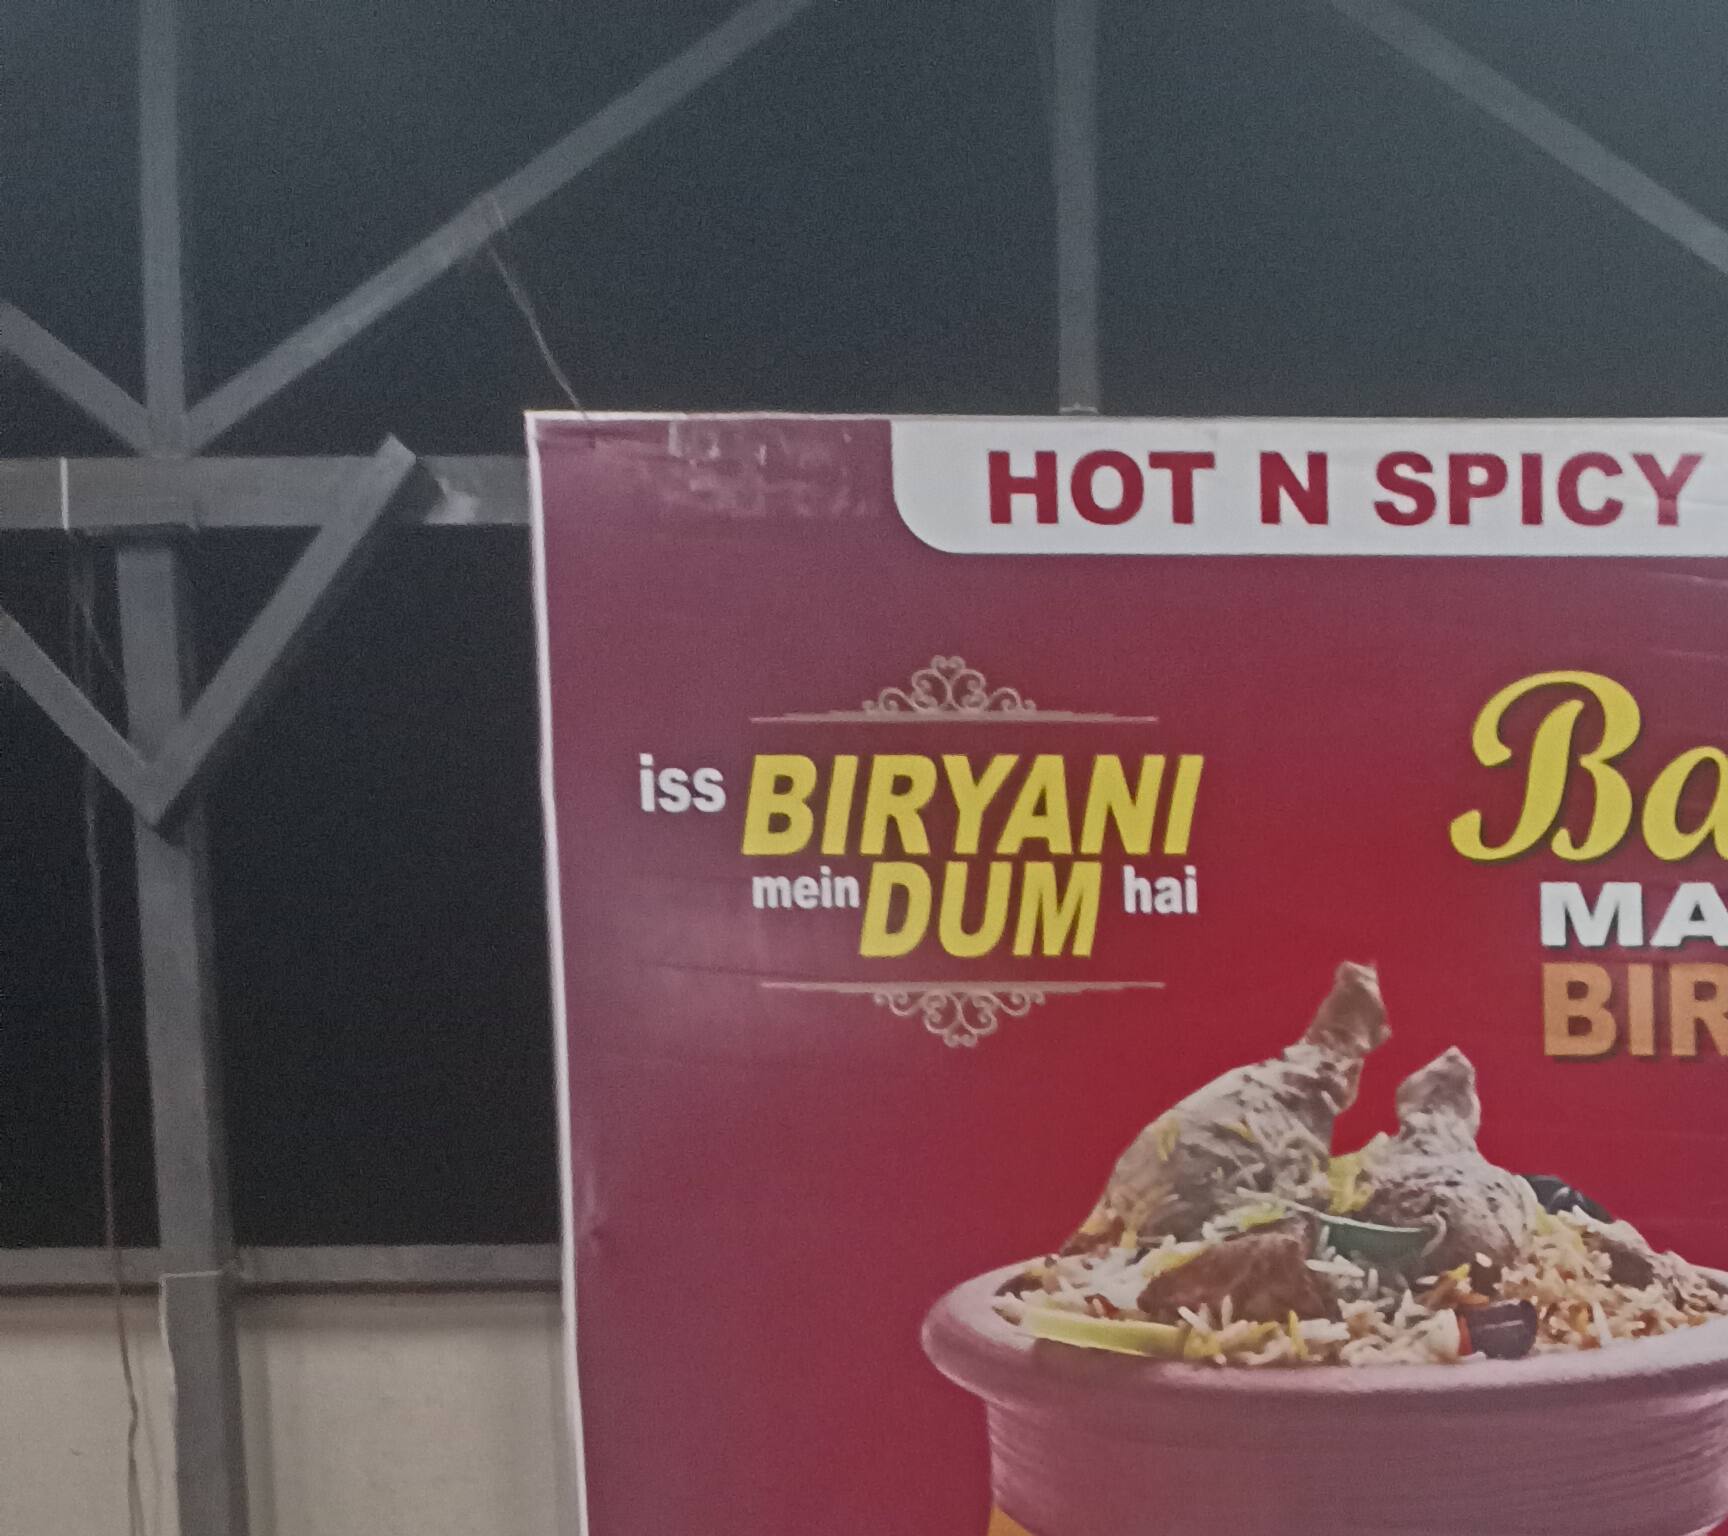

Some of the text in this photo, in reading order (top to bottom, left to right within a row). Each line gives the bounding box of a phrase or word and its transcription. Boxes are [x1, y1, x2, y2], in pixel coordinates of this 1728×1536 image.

[988, 450, 1701, 526] HOT N SPICY
[640, 753, 1203, 855] iss BIRYANI
[752, 861, 1197, 957] mein DUM hai
